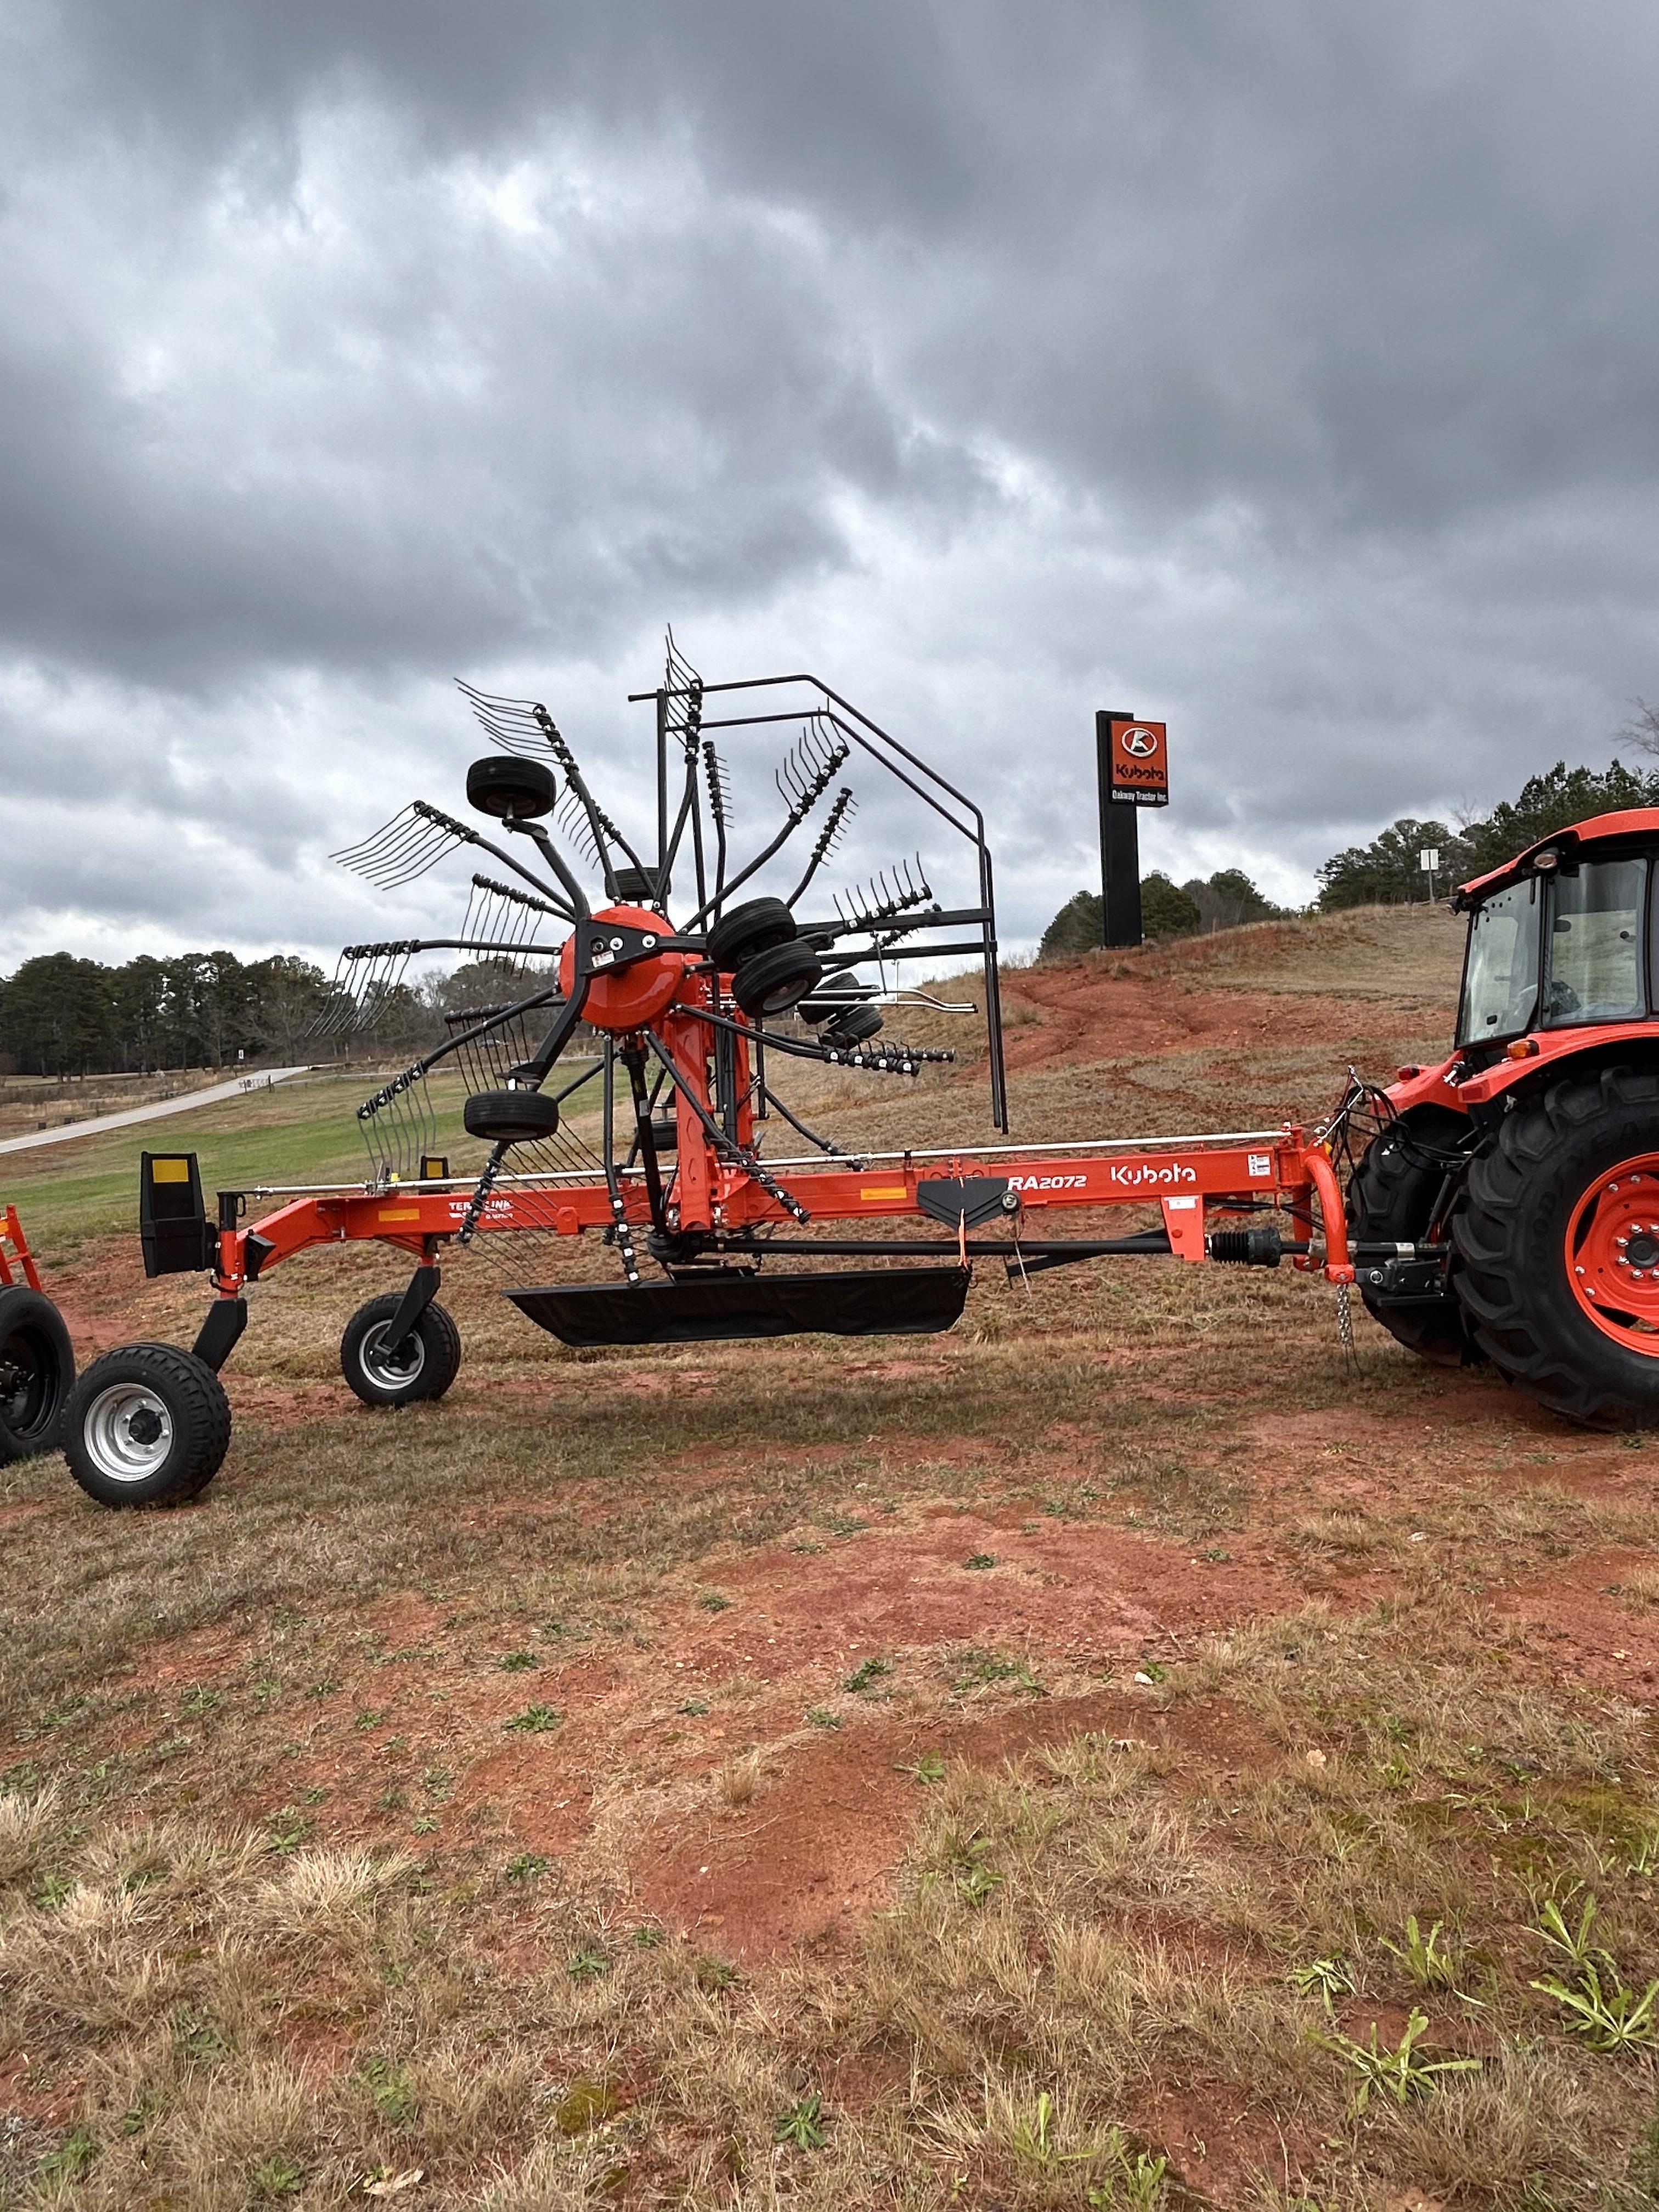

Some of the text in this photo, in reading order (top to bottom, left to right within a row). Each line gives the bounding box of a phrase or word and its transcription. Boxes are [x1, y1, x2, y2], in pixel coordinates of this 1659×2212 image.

[1116, 764, 1164, 781] Kubota
[1007, 1175, 1087, 1190] RA2072
[1110, 1163, 1197, 1185] Kubota
